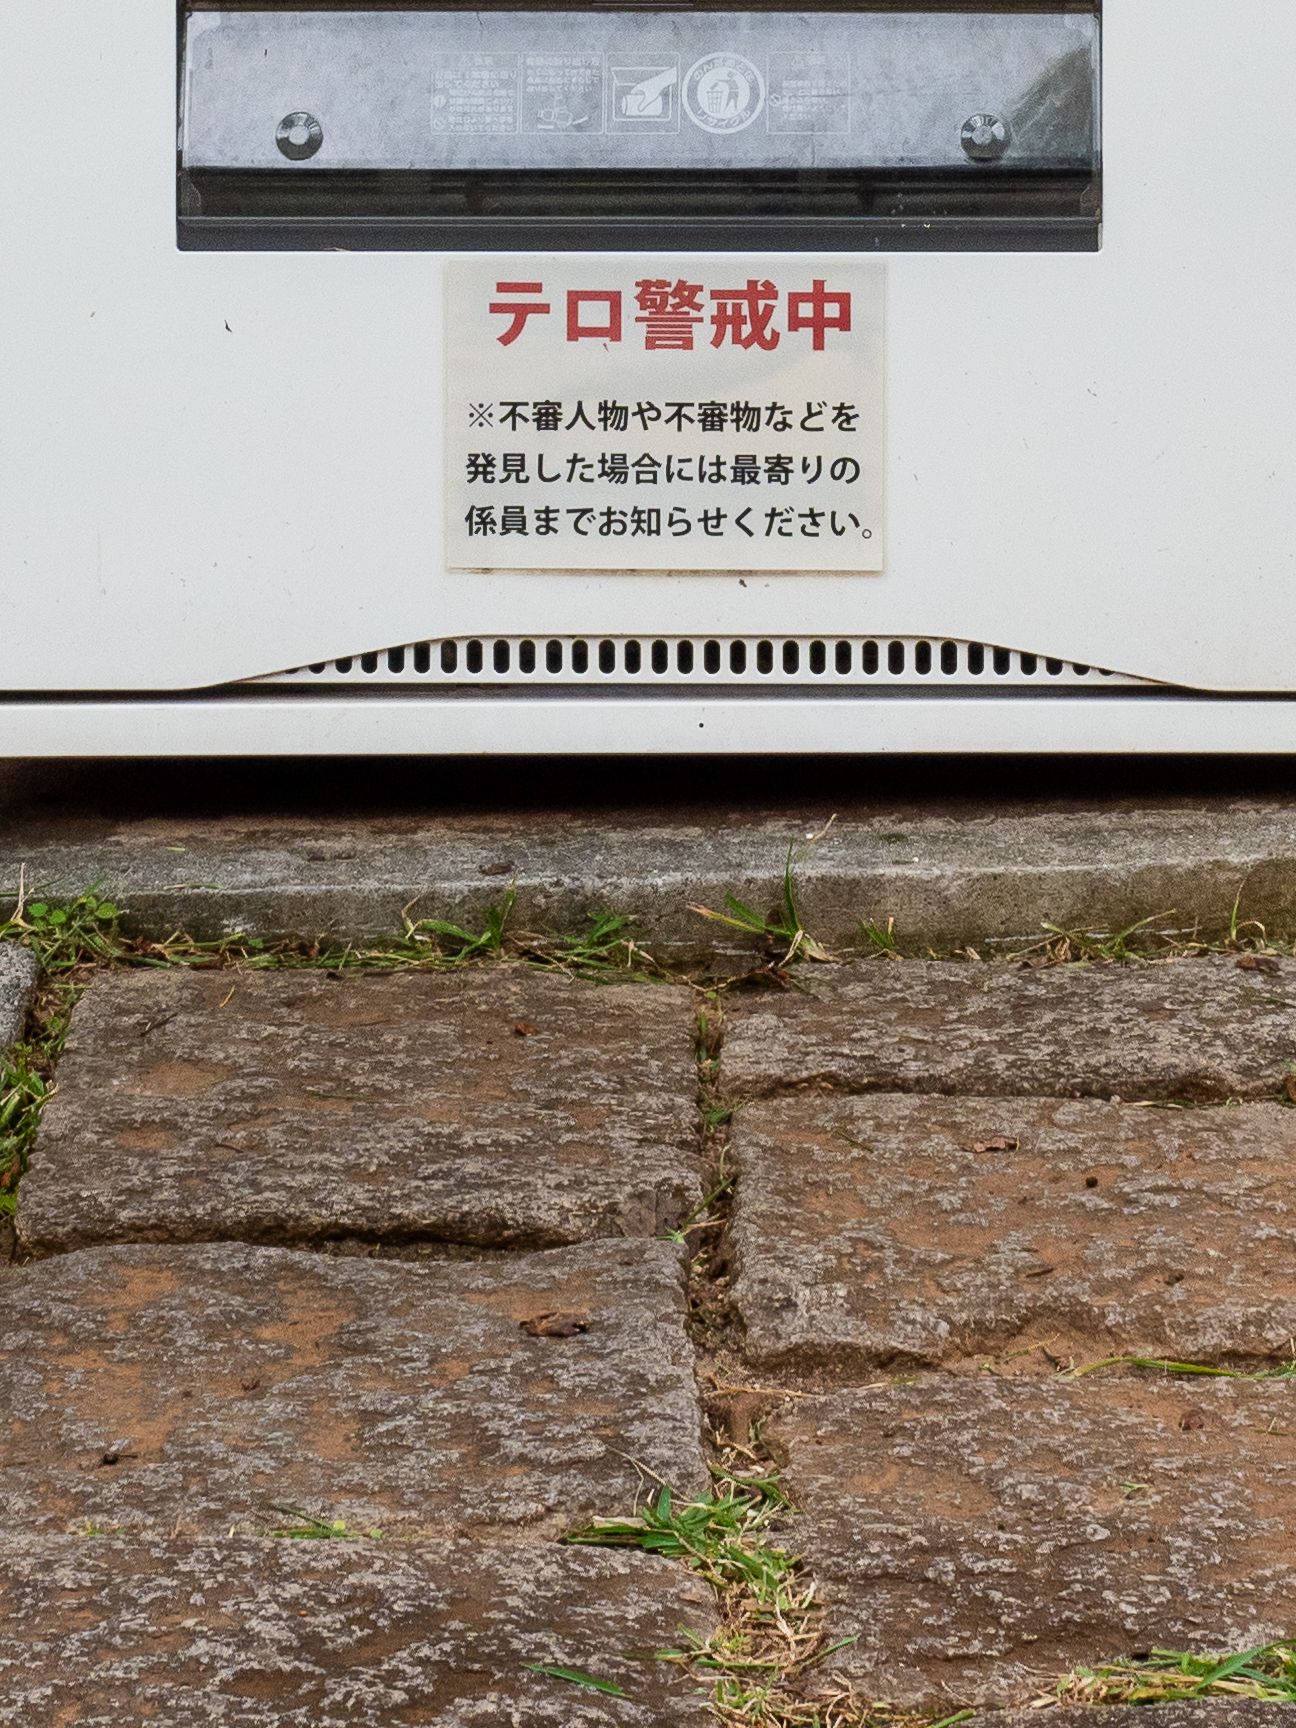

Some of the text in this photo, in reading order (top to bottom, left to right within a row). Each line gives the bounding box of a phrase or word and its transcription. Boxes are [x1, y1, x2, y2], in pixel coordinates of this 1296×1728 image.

[488, 278, 852, 351] テロ警戒中
[467, 400, 860, 433] ※不審人物や不審物などを
[465, 452, 861, 486] 発見した場合には最寄りの
[465, 505, 873, 540] 係員までお知らせください。
